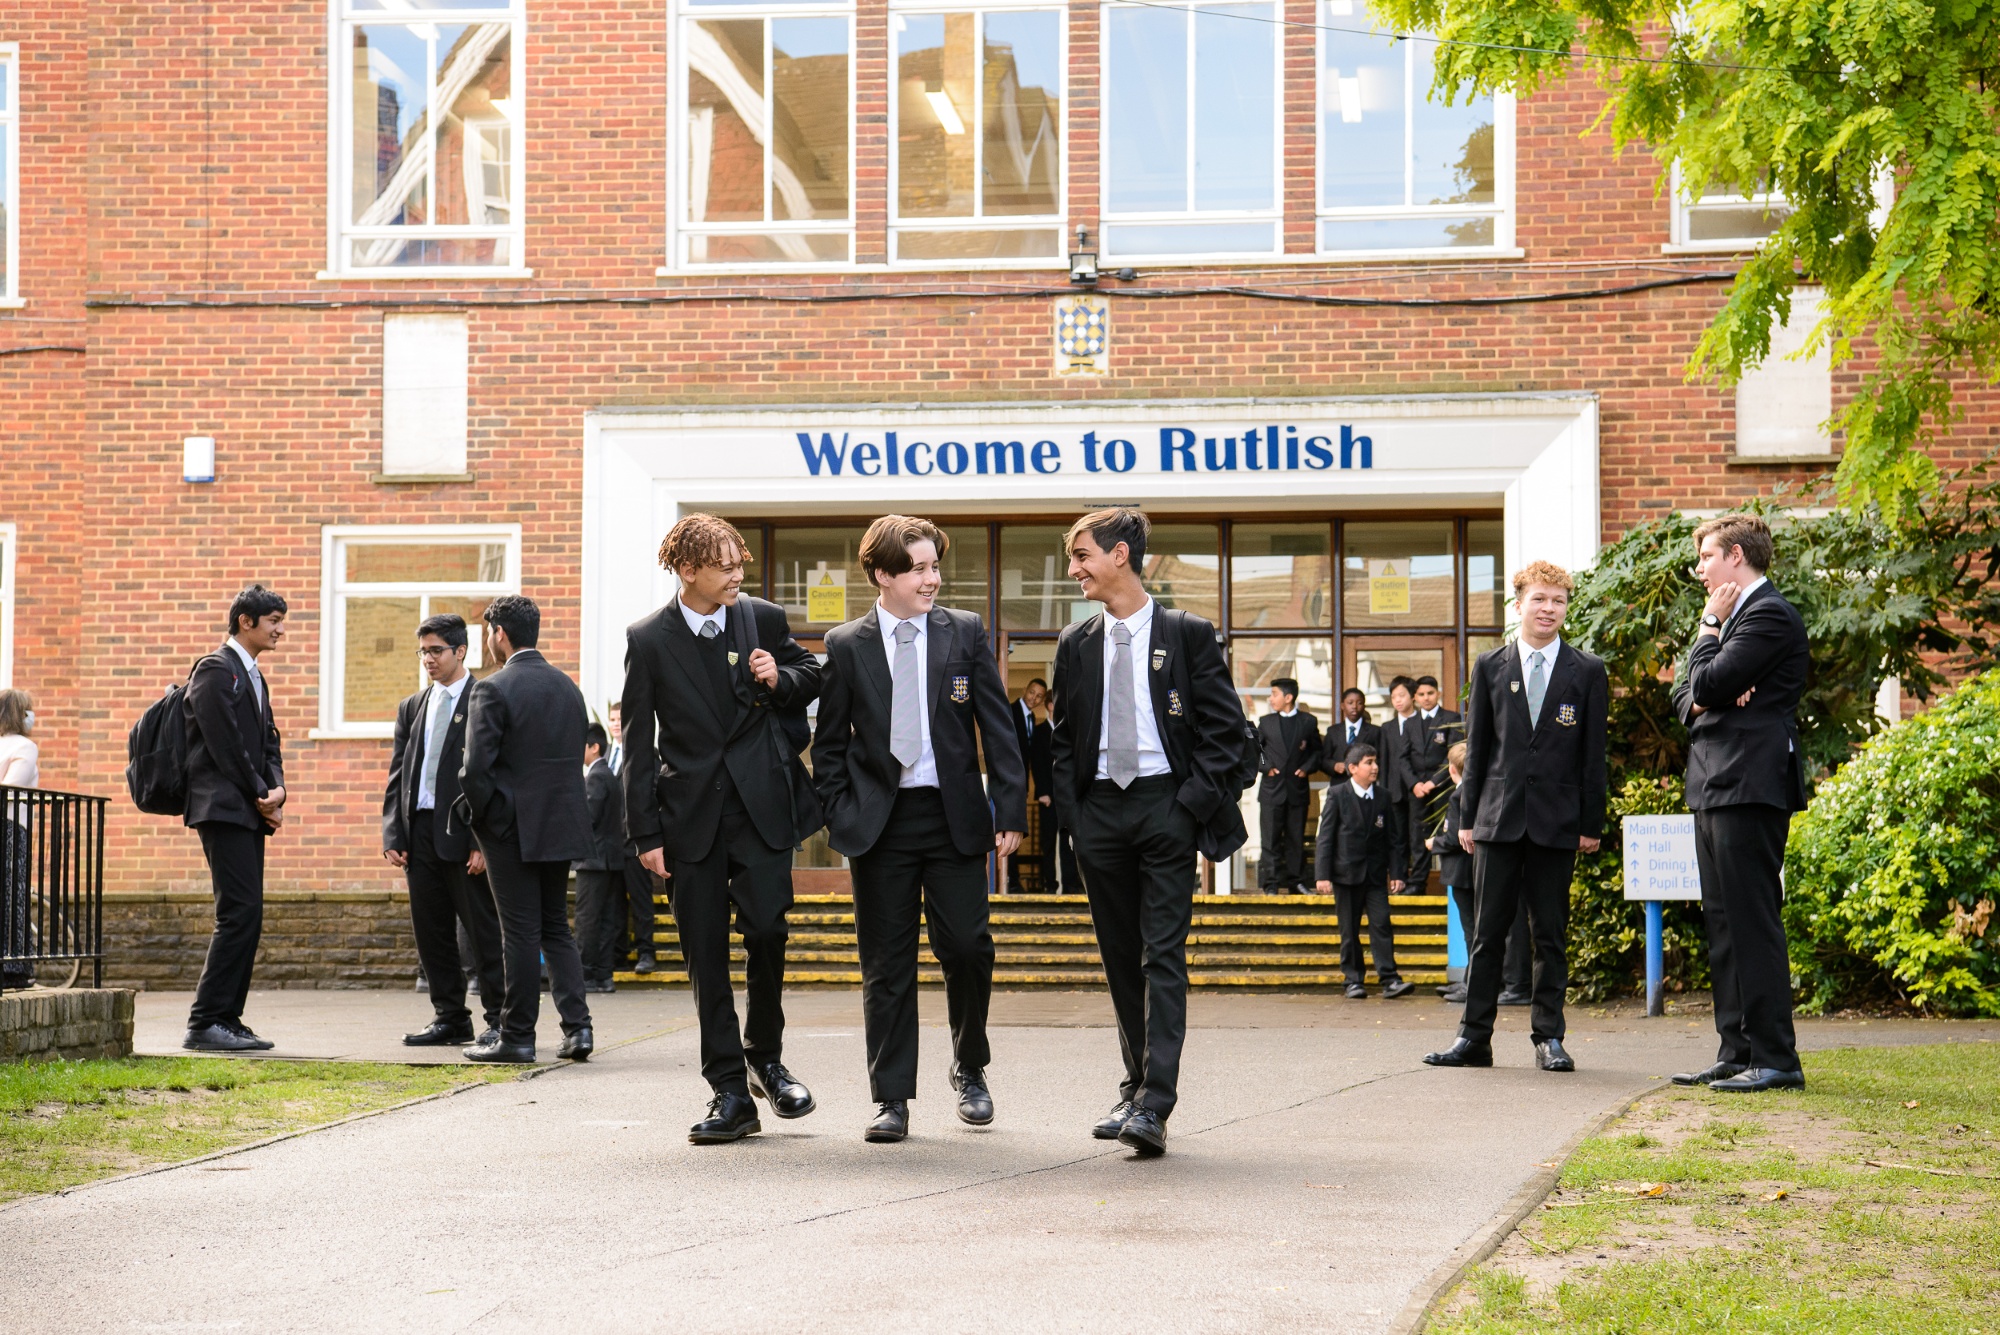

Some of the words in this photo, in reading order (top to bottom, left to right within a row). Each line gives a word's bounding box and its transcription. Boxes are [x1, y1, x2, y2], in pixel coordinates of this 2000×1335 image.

[796, 431, 1061, 476] Welcome
[1080, 431, 1137, 473] to
[1159, 425, 1373, 472] Rutlish
[1373, 580, 1406, 589] Caution
[811, 590, 843, 598] Caution
[1629, 822, 1657, 835] Main
[1648, 841, 1671, 852] Hall
[1649, 859, 1687, 873] Dining
[1649, 877, 1678, 891] Pupil
